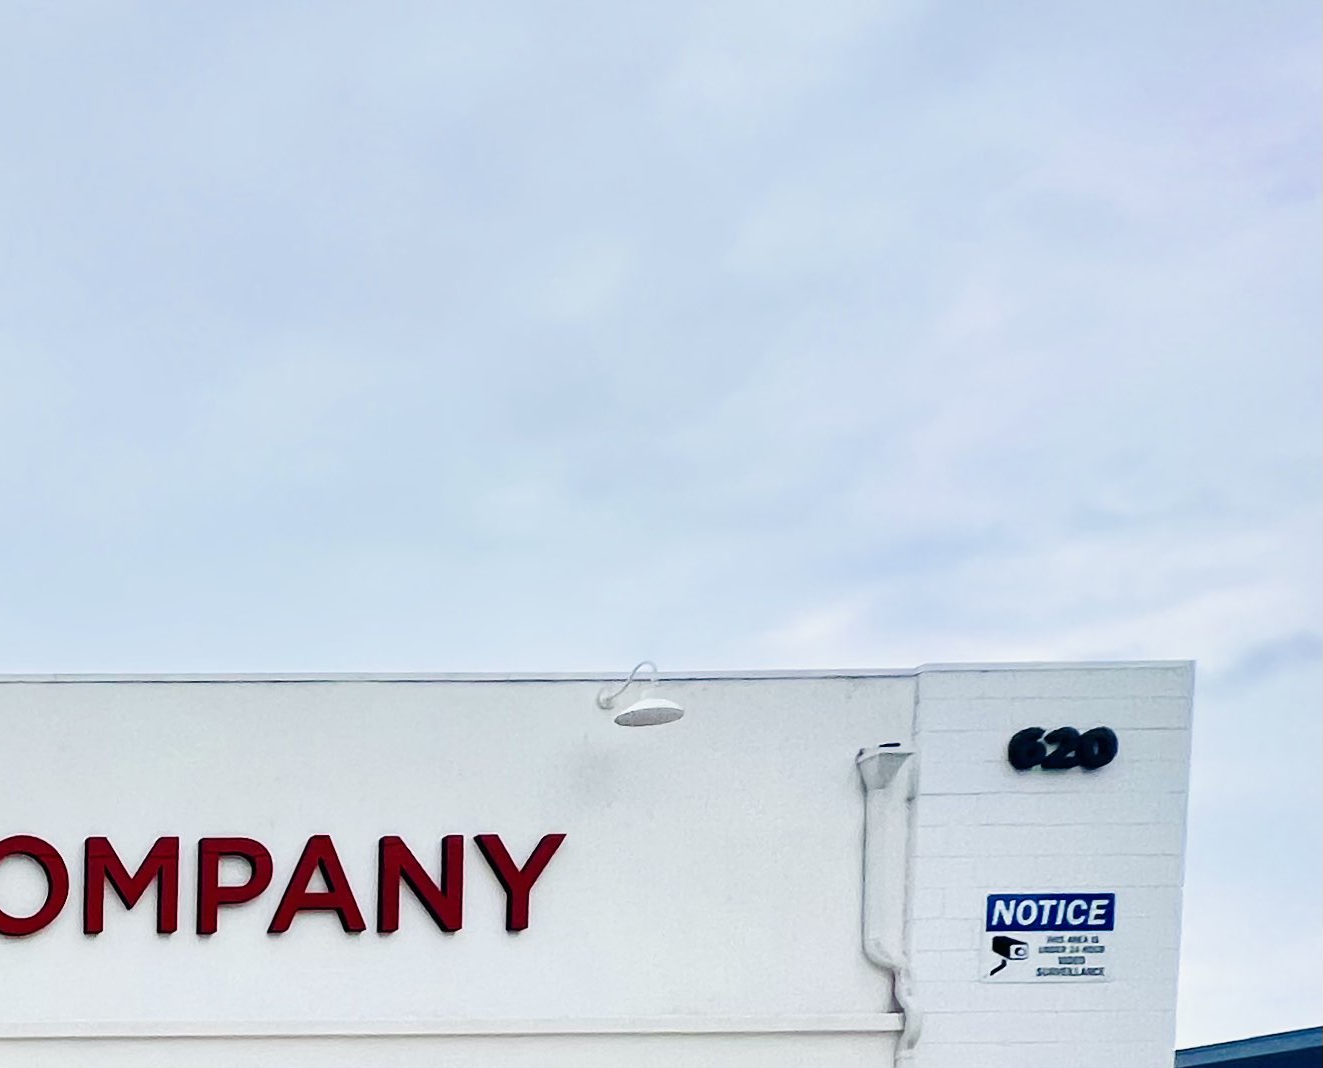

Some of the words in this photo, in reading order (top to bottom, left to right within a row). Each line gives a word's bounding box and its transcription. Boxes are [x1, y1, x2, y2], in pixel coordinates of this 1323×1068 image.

[1008, 727, 1117, 771] 620
[991, 899, 1109, 926] NOTICE
[1036, 967, 1105, 976] SURVEILLANCE
